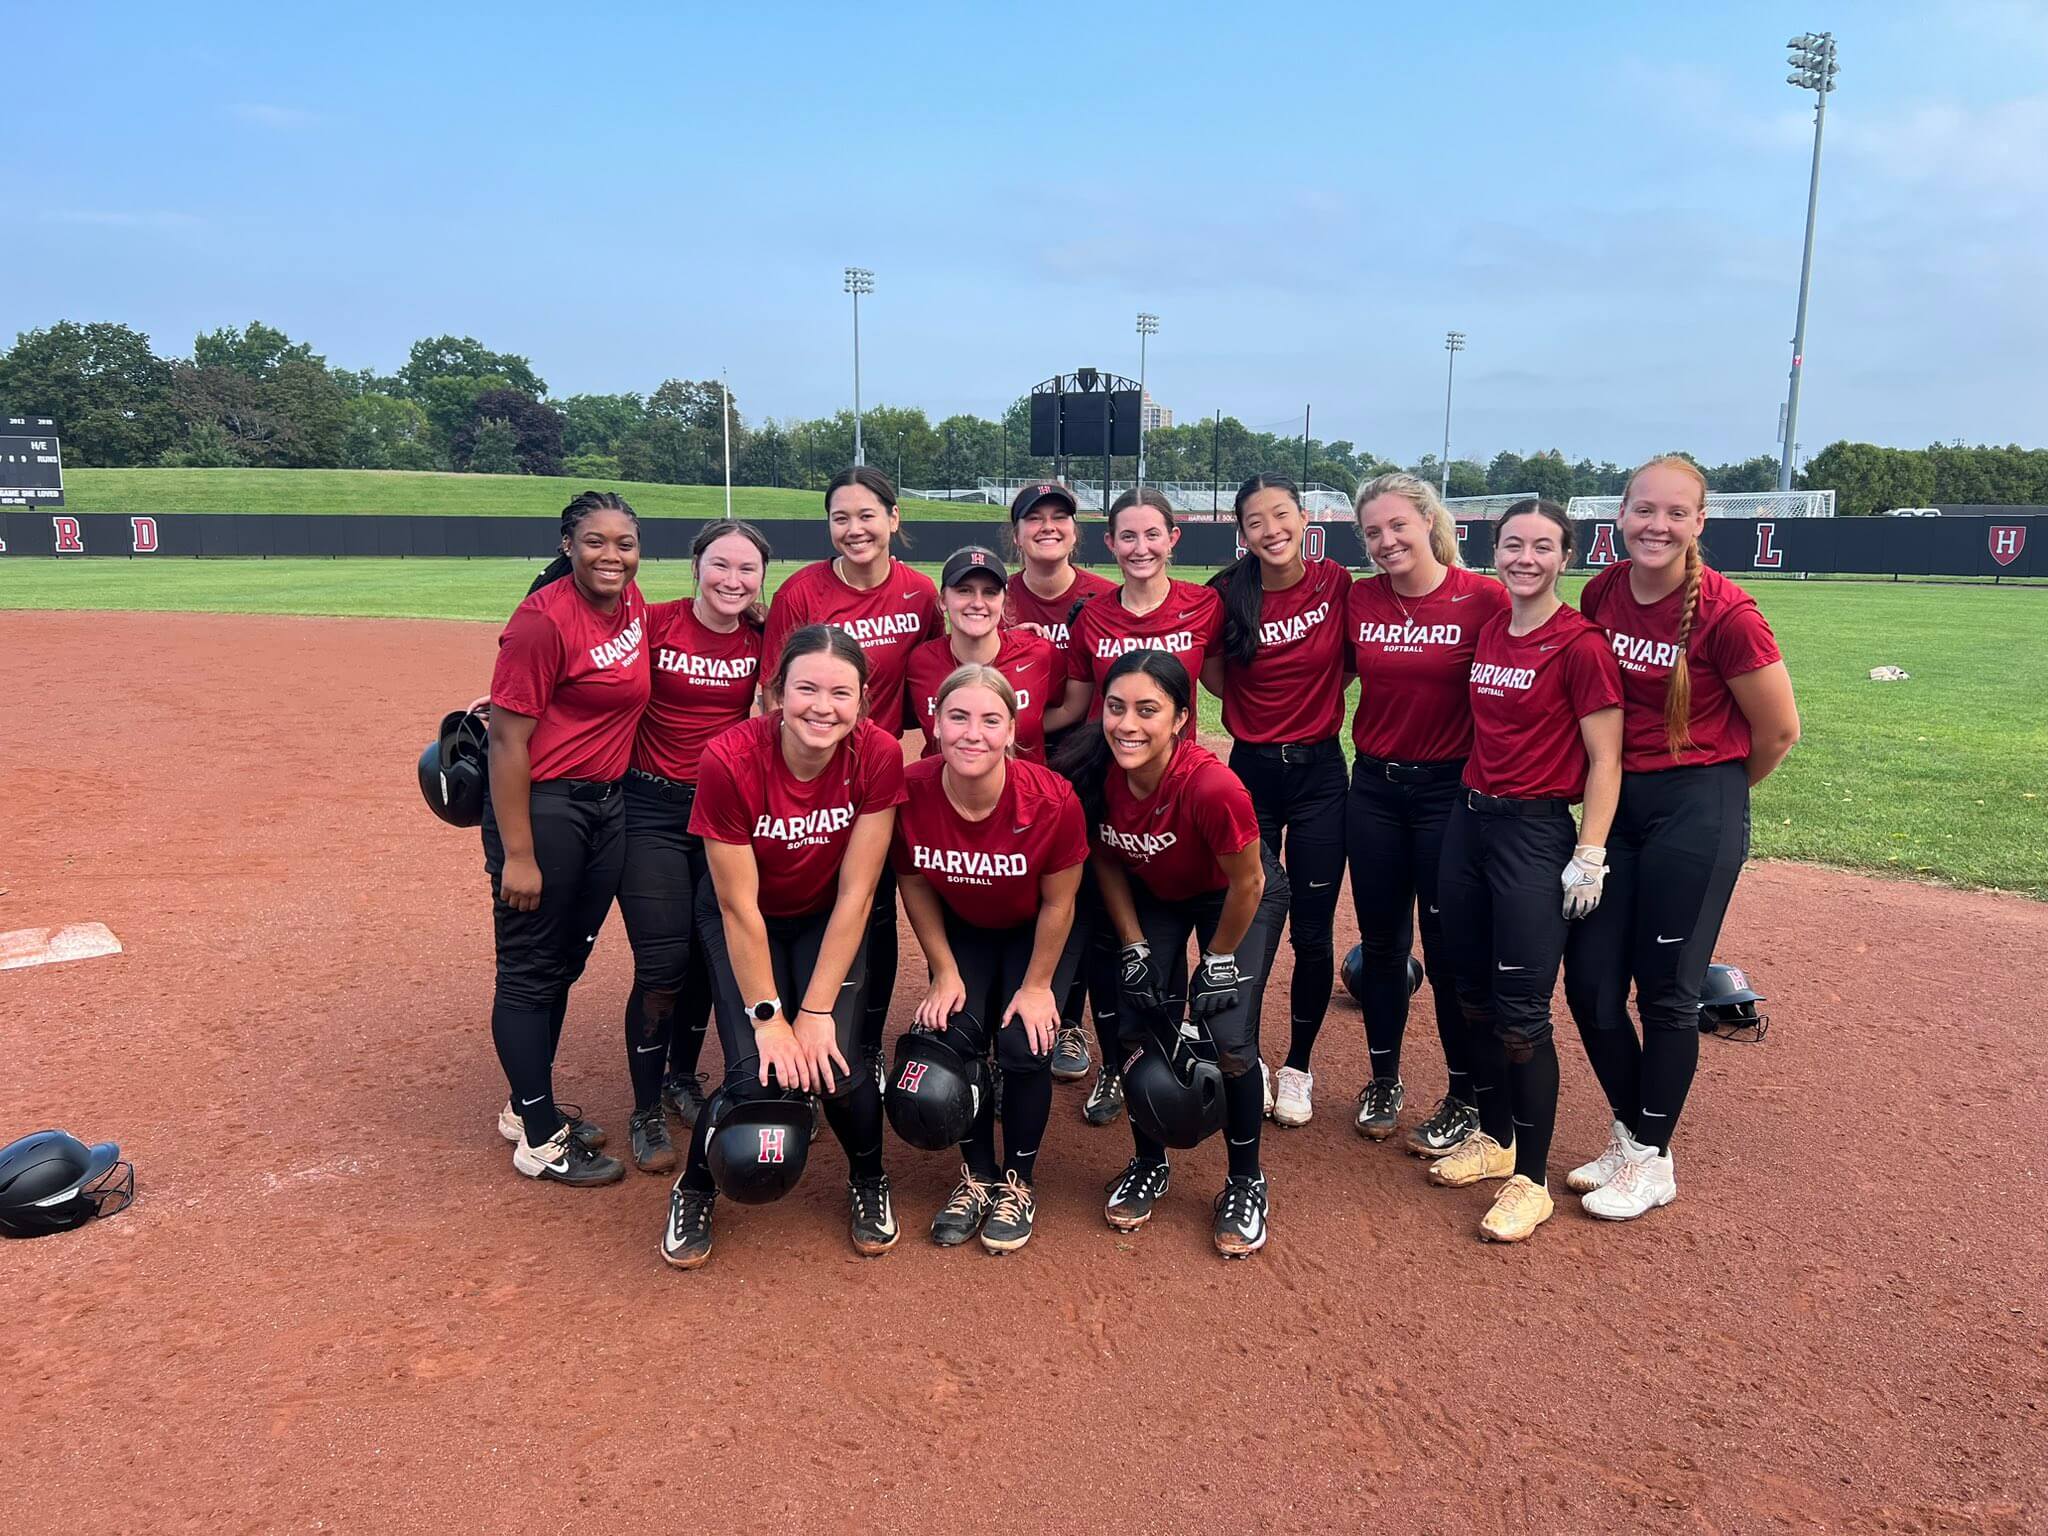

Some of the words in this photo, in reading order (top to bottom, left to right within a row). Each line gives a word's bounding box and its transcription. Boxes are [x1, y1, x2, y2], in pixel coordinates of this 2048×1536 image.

[826, 612, 921, 641] ARVARD
[1359, 622, 1462, 645] HARVARD
[860, 636, 897, 649] SOFTBALL
[1383, 644, 1424, 653] SOFTBALL
[657, 648, 757, 679] HARVARD
[1469, 661, 1537, 690] HARVARD
[688, 677, 731, 687] SOFTBALL
[1477, 685, 1505, 697] SOFTBALL
[913, 845, 1028, 877] HARVARD
[946, 875, 993, 886] SOFTBALL
[897, 1060, 929, 1093] H
[757, 1128, 786, 1163] H
